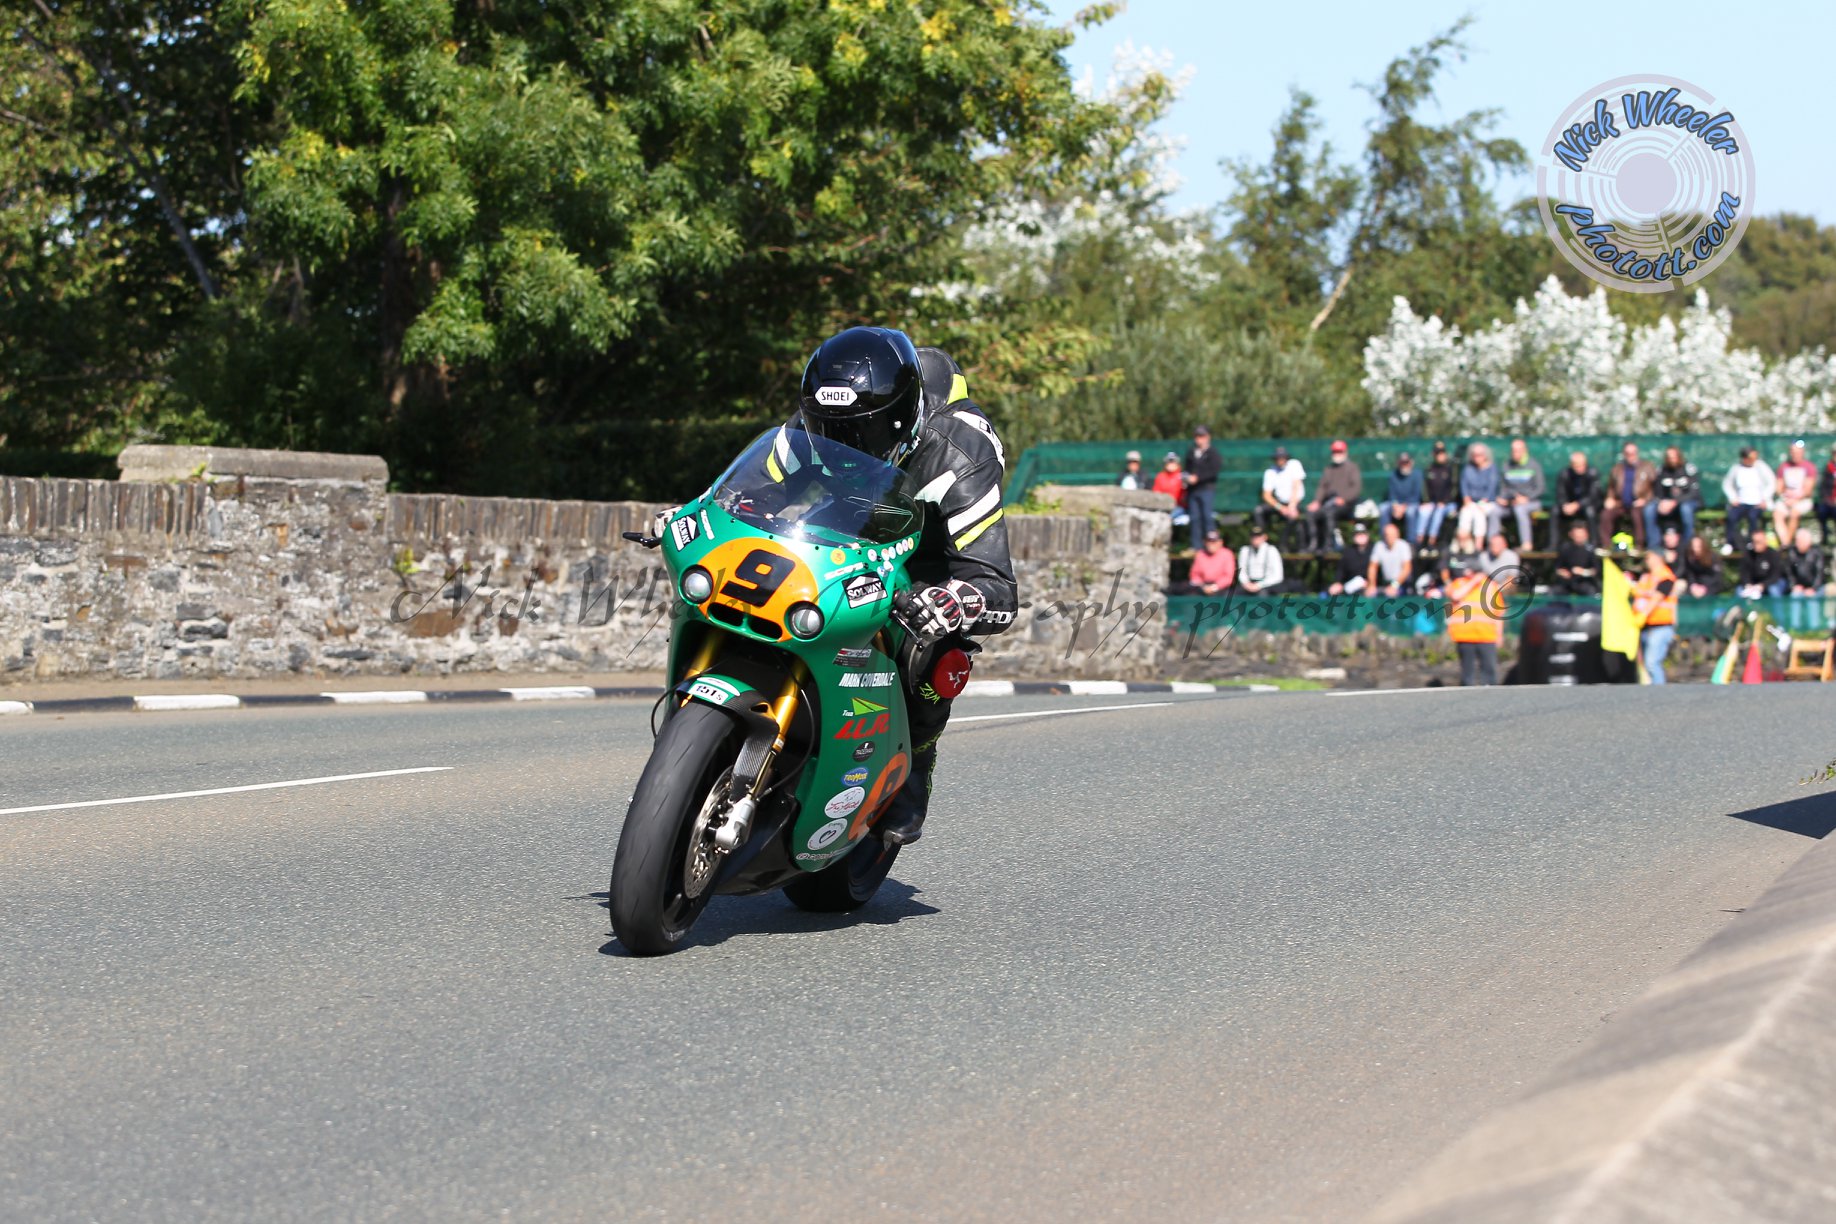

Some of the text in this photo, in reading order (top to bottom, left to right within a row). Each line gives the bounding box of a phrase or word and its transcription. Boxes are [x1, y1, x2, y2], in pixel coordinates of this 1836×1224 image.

[821, 391, 850, 401] SHOEI
[677, 516, 692, 546] SOLWAY
[719, 548, 796, 609] 9
[847, 582, 883, 599] SOLWAY
[838, 672, 896, 688] MARK COVERDALE
